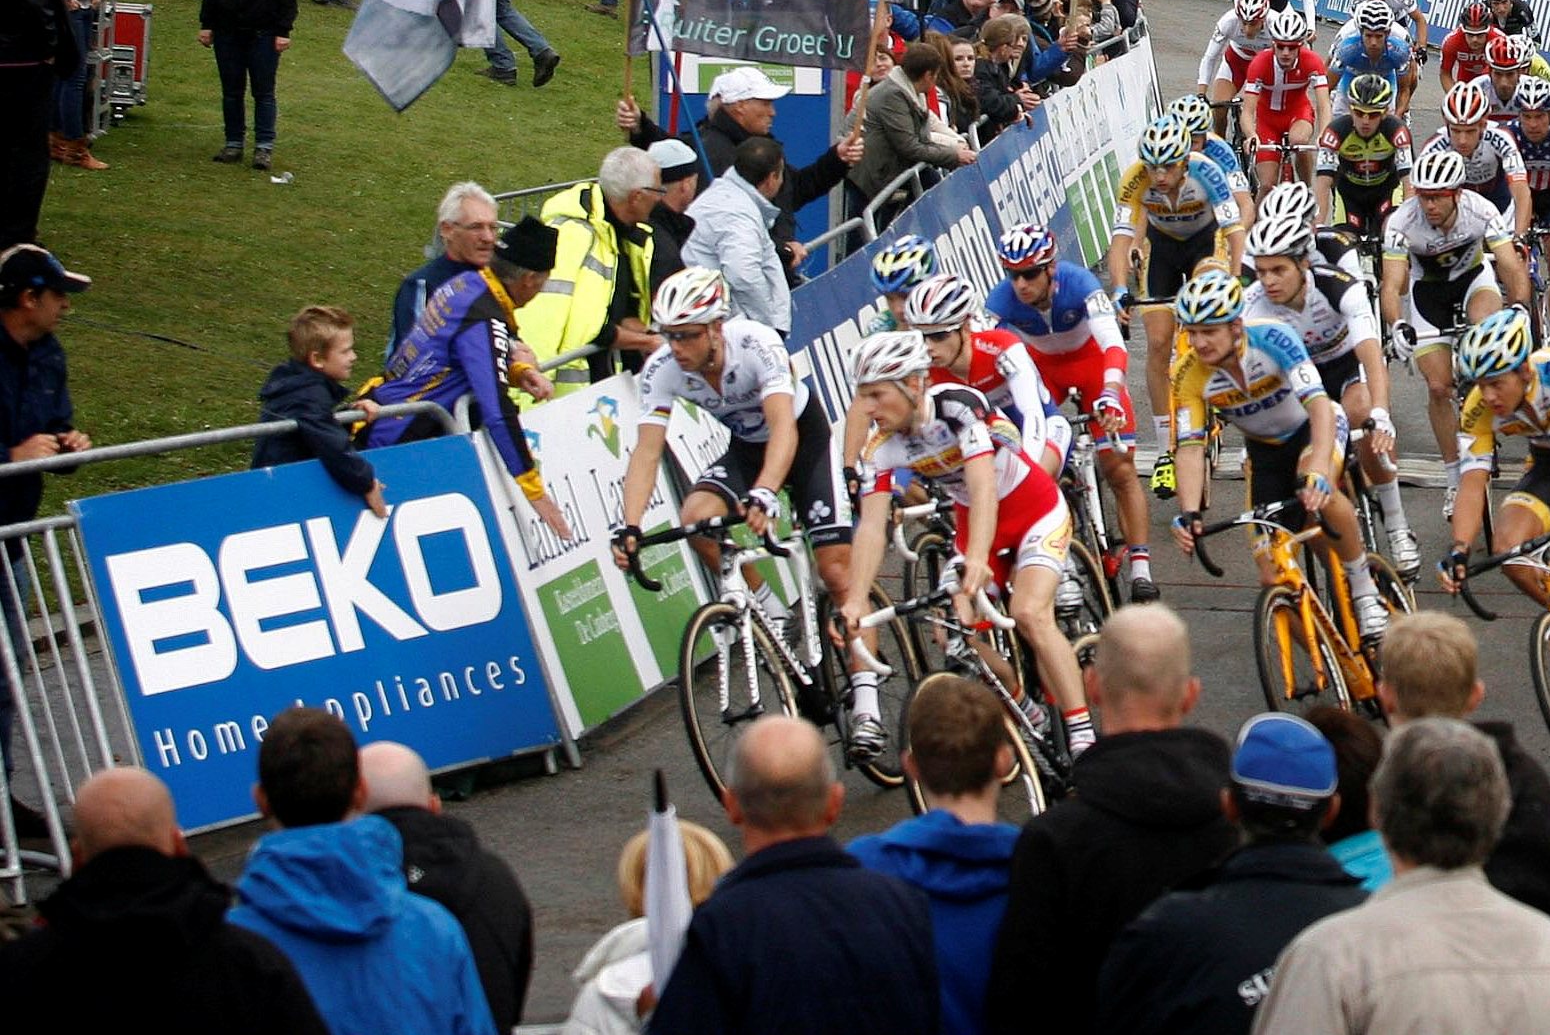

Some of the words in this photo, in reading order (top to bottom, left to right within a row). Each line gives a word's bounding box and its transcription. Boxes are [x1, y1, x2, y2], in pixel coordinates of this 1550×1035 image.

[754, 26, 829, 56] Groet
[836, 34, 855, 58] U
[105, 492, 503, 696] BEKO
[153, 713, 269, 767] Home
[296, 654, 526, 732] ppliances
